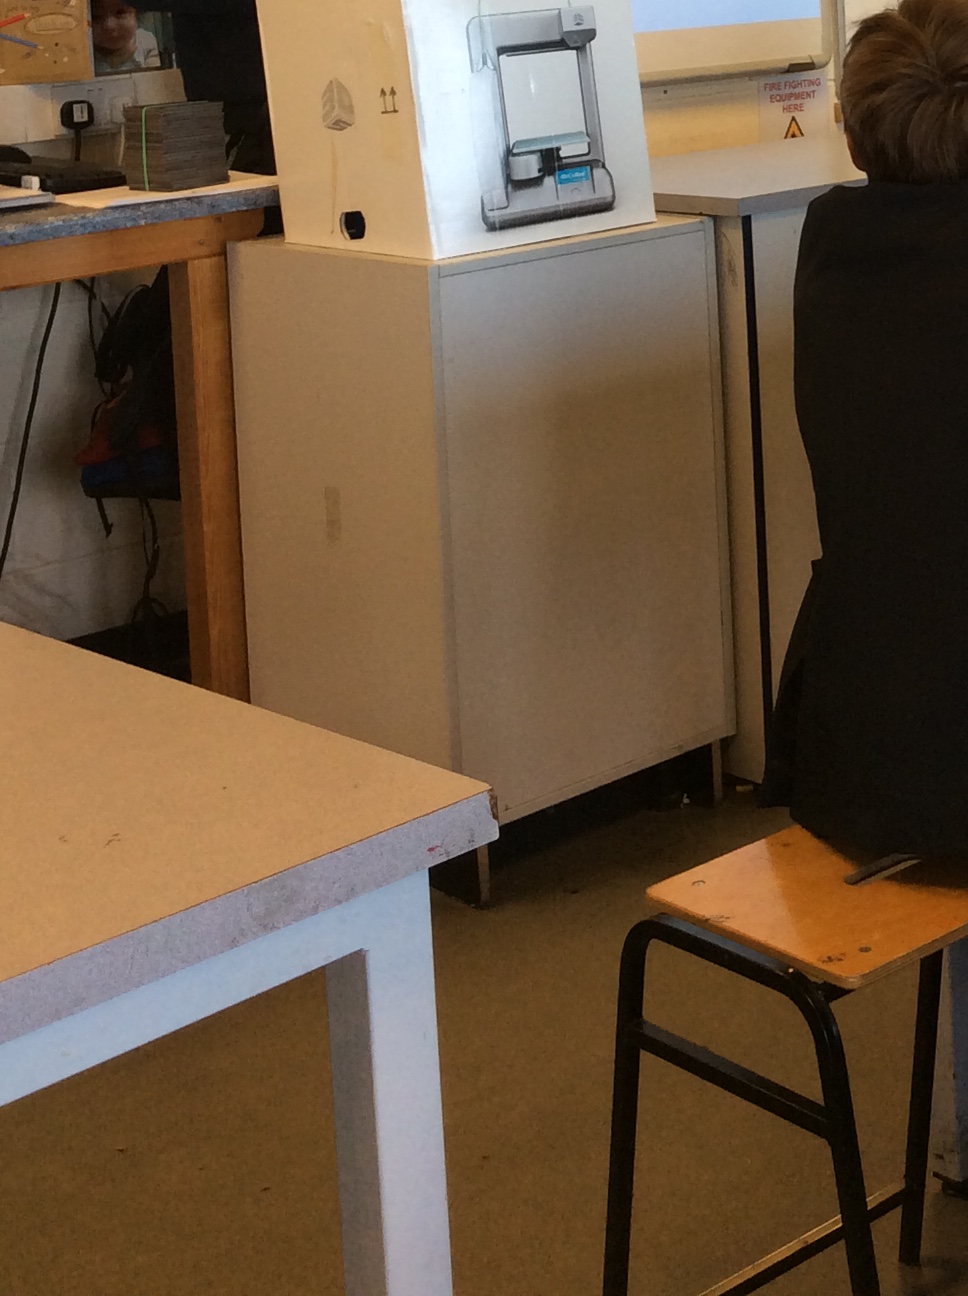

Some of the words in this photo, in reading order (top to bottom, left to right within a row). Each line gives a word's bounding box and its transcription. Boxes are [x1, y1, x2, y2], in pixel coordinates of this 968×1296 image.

[763, 82, 782, 92] FIRE
[783, 77, 821, 90] FIGHTING
[769, 89, 817, 103] EQUIPMENT
[782, 103, 805, 114] HERE
